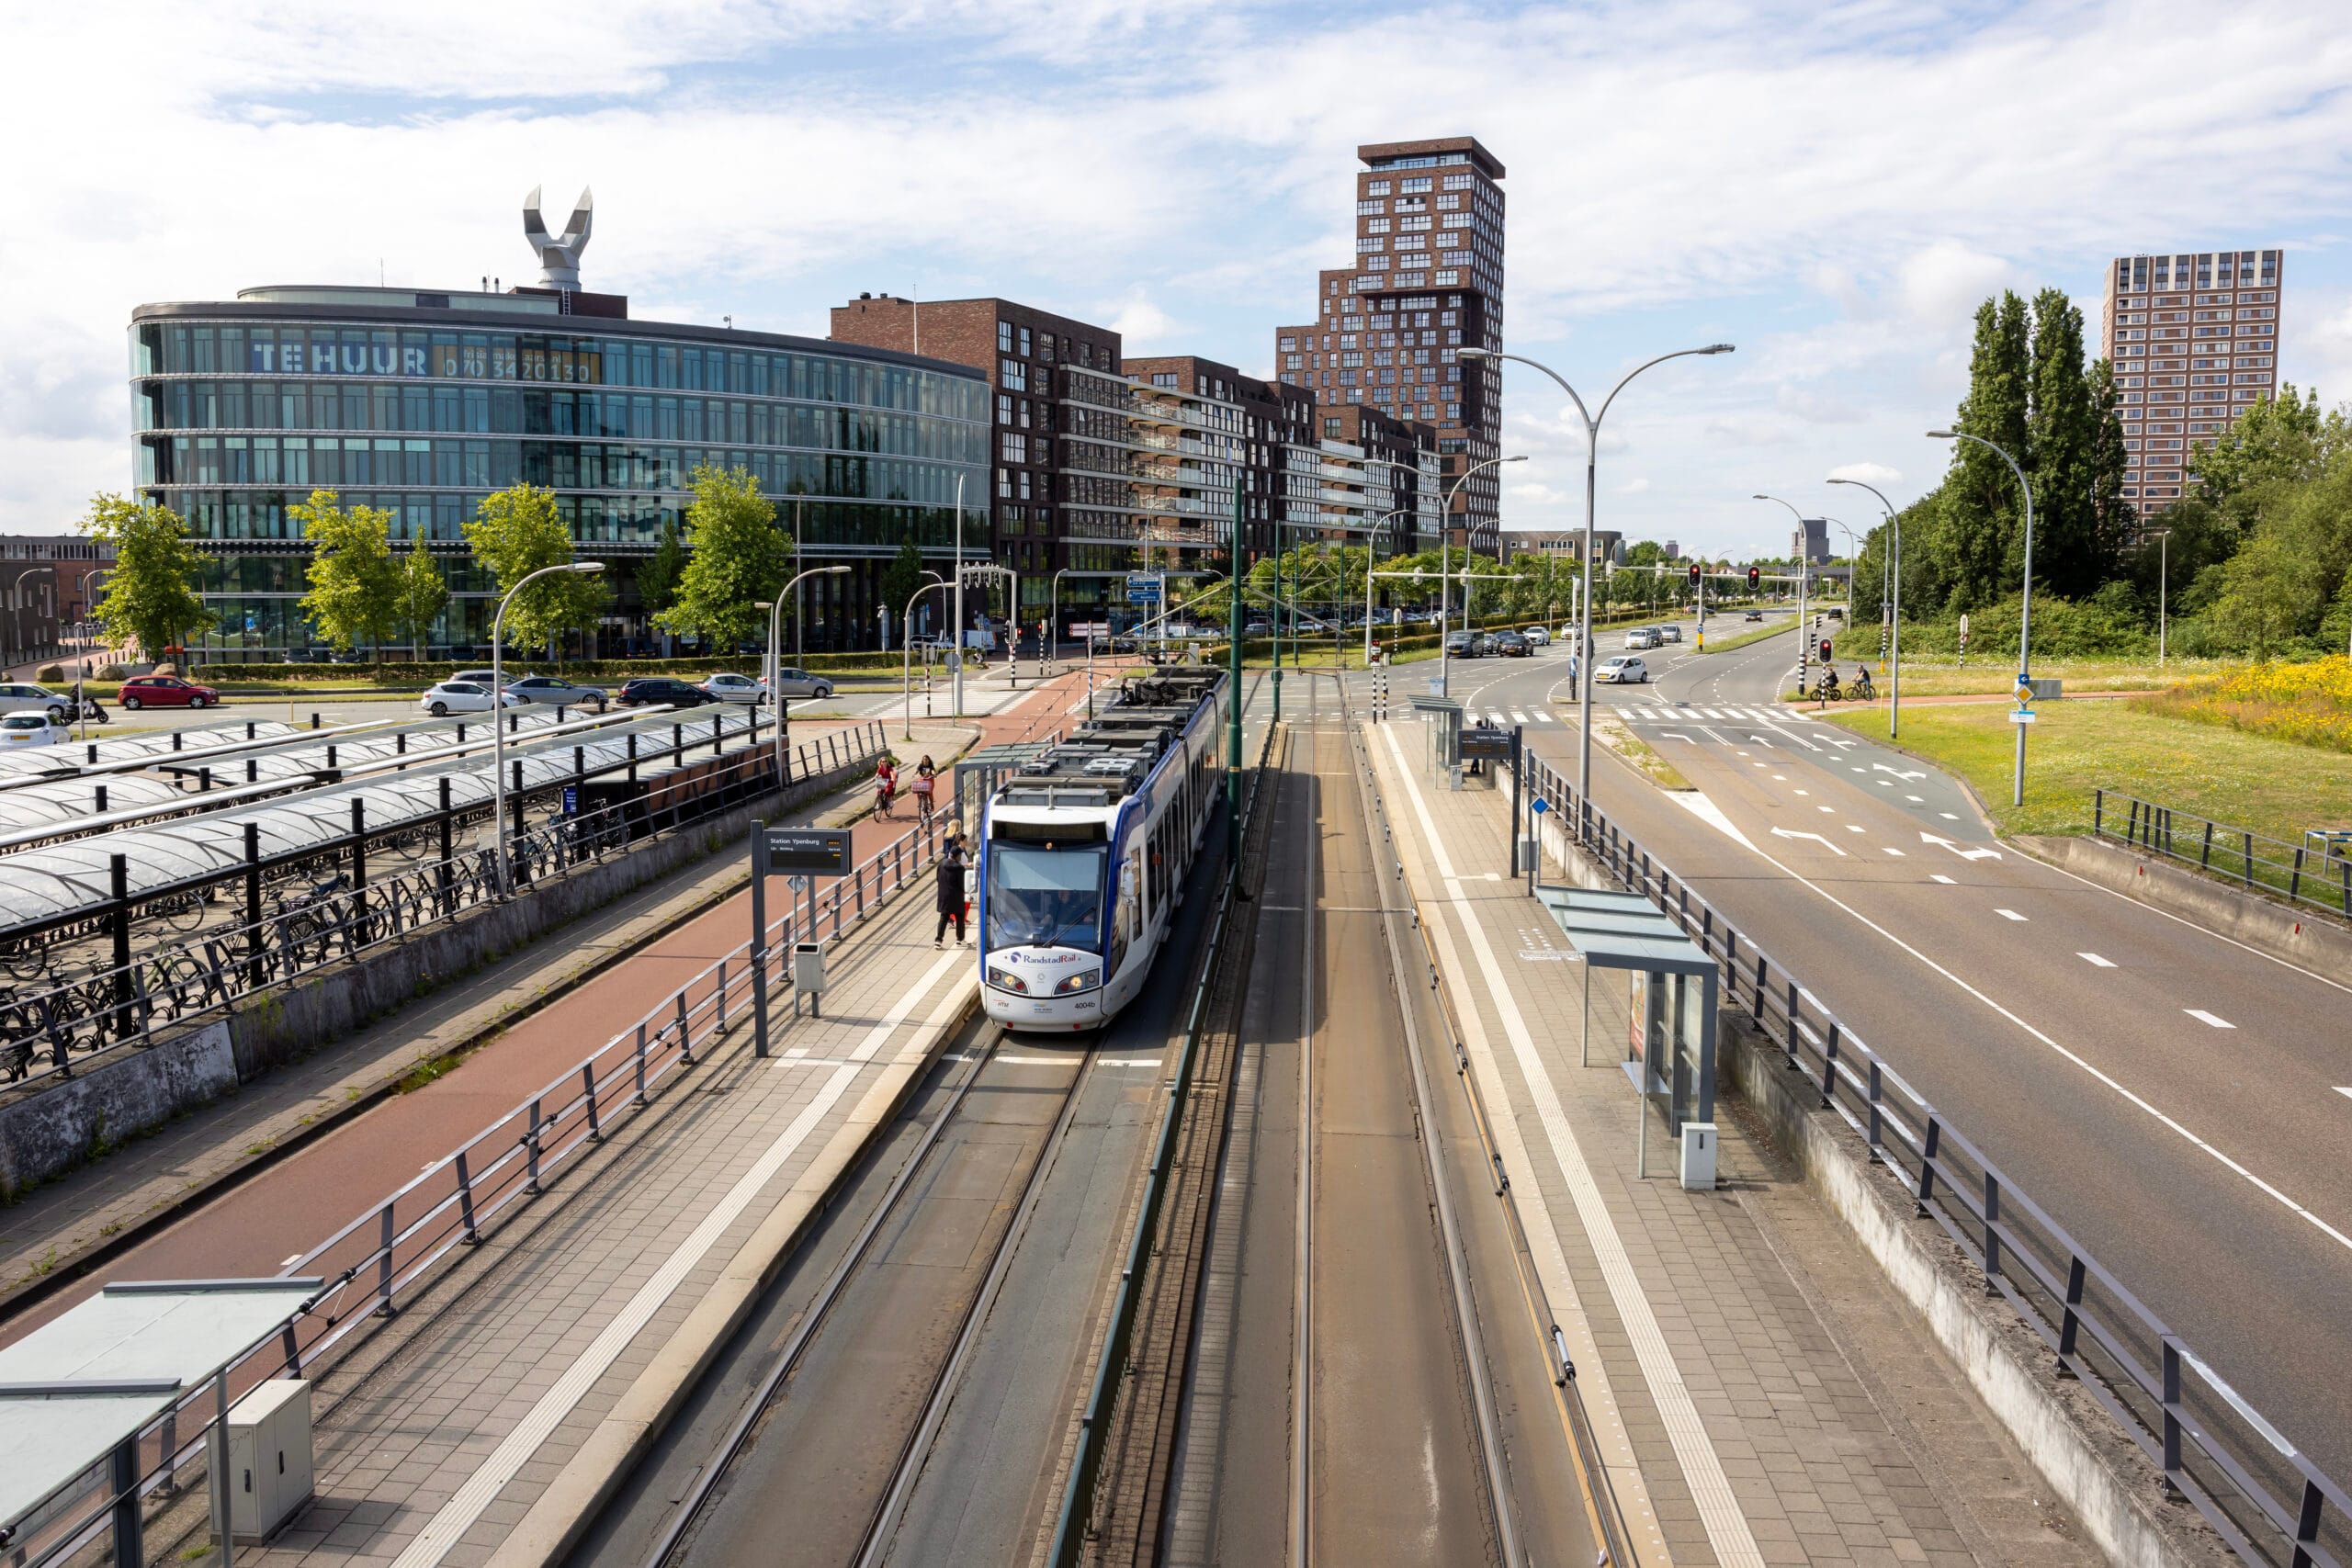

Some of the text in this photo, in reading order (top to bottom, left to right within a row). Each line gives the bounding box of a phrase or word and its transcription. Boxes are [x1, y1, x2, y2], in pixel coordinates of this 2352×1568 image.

[254, 344, 426, 375] TE HUUR
[1023, 953, 1076, 964] RandstadRail
